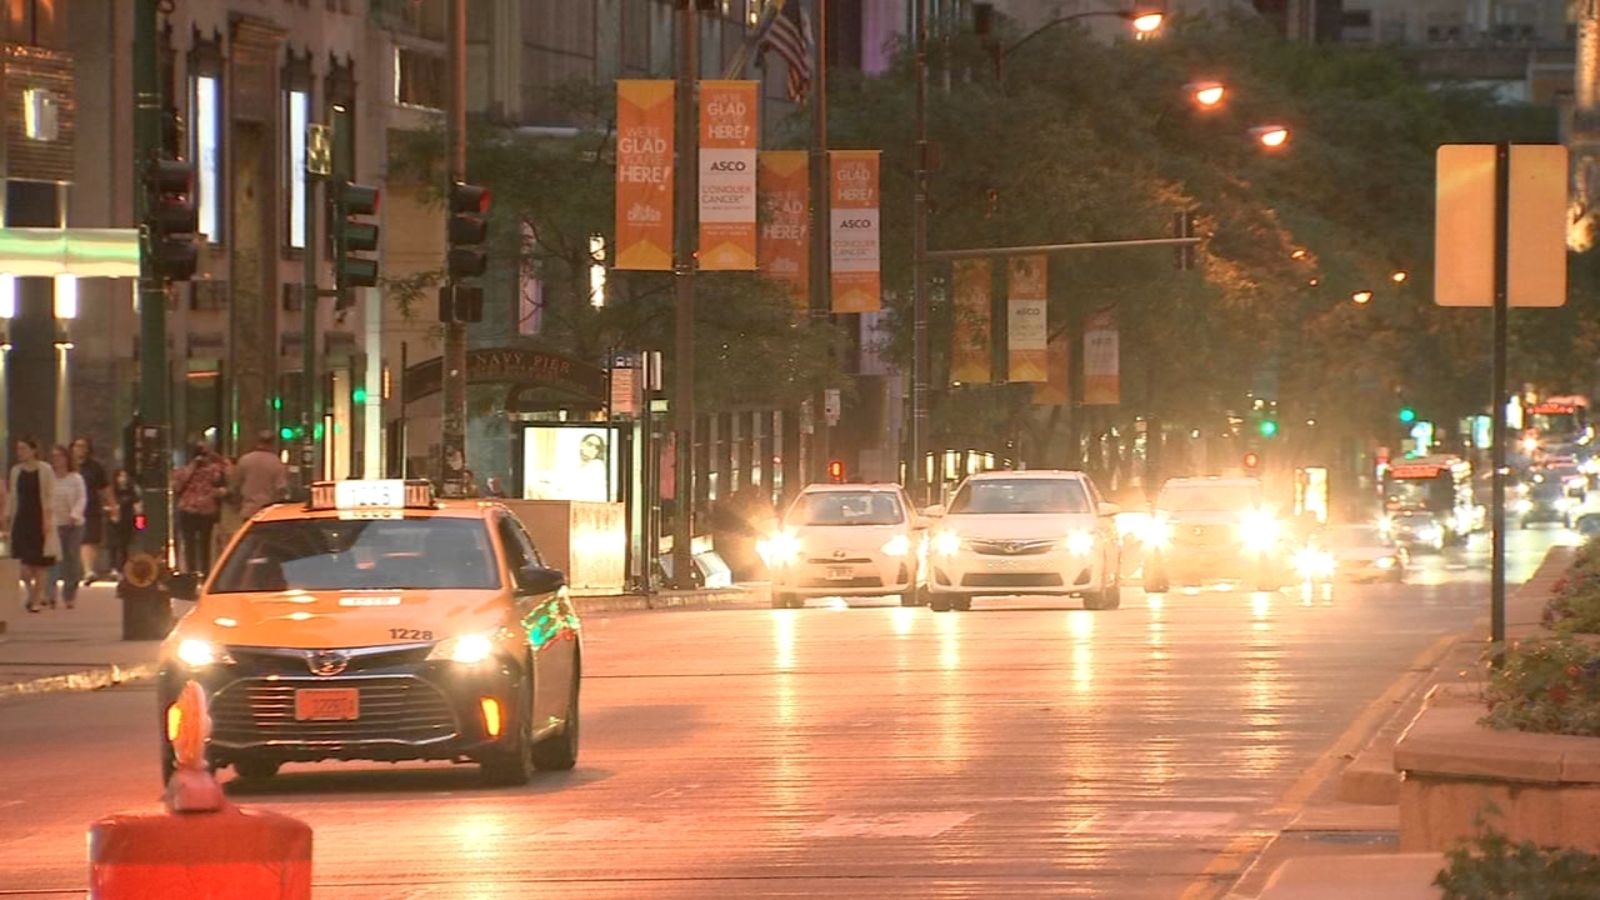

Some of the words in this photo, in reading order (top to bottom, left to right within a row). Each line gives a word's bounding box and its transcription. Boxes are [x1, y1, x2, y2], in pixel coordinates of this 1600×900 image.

[707, 102, 746, 116] GLAD
[708, 124, 750, 146] HERE!
[619, 138, 667, 154] GLAD
[710, 161, 746, 171] ASCO
[619, 165, 671, 190] HERE!
[837, 169, 870, 181] GLAD
[838, 187, 873, 206] HERE!
[840, 219, 871, 229] ASCO
[763, 224, 806, 247] HERE!
[475, 352, 521, 365] NAVY
[533, 355, 571, 374] PIER
[387, 628, 434, 641] 1228
